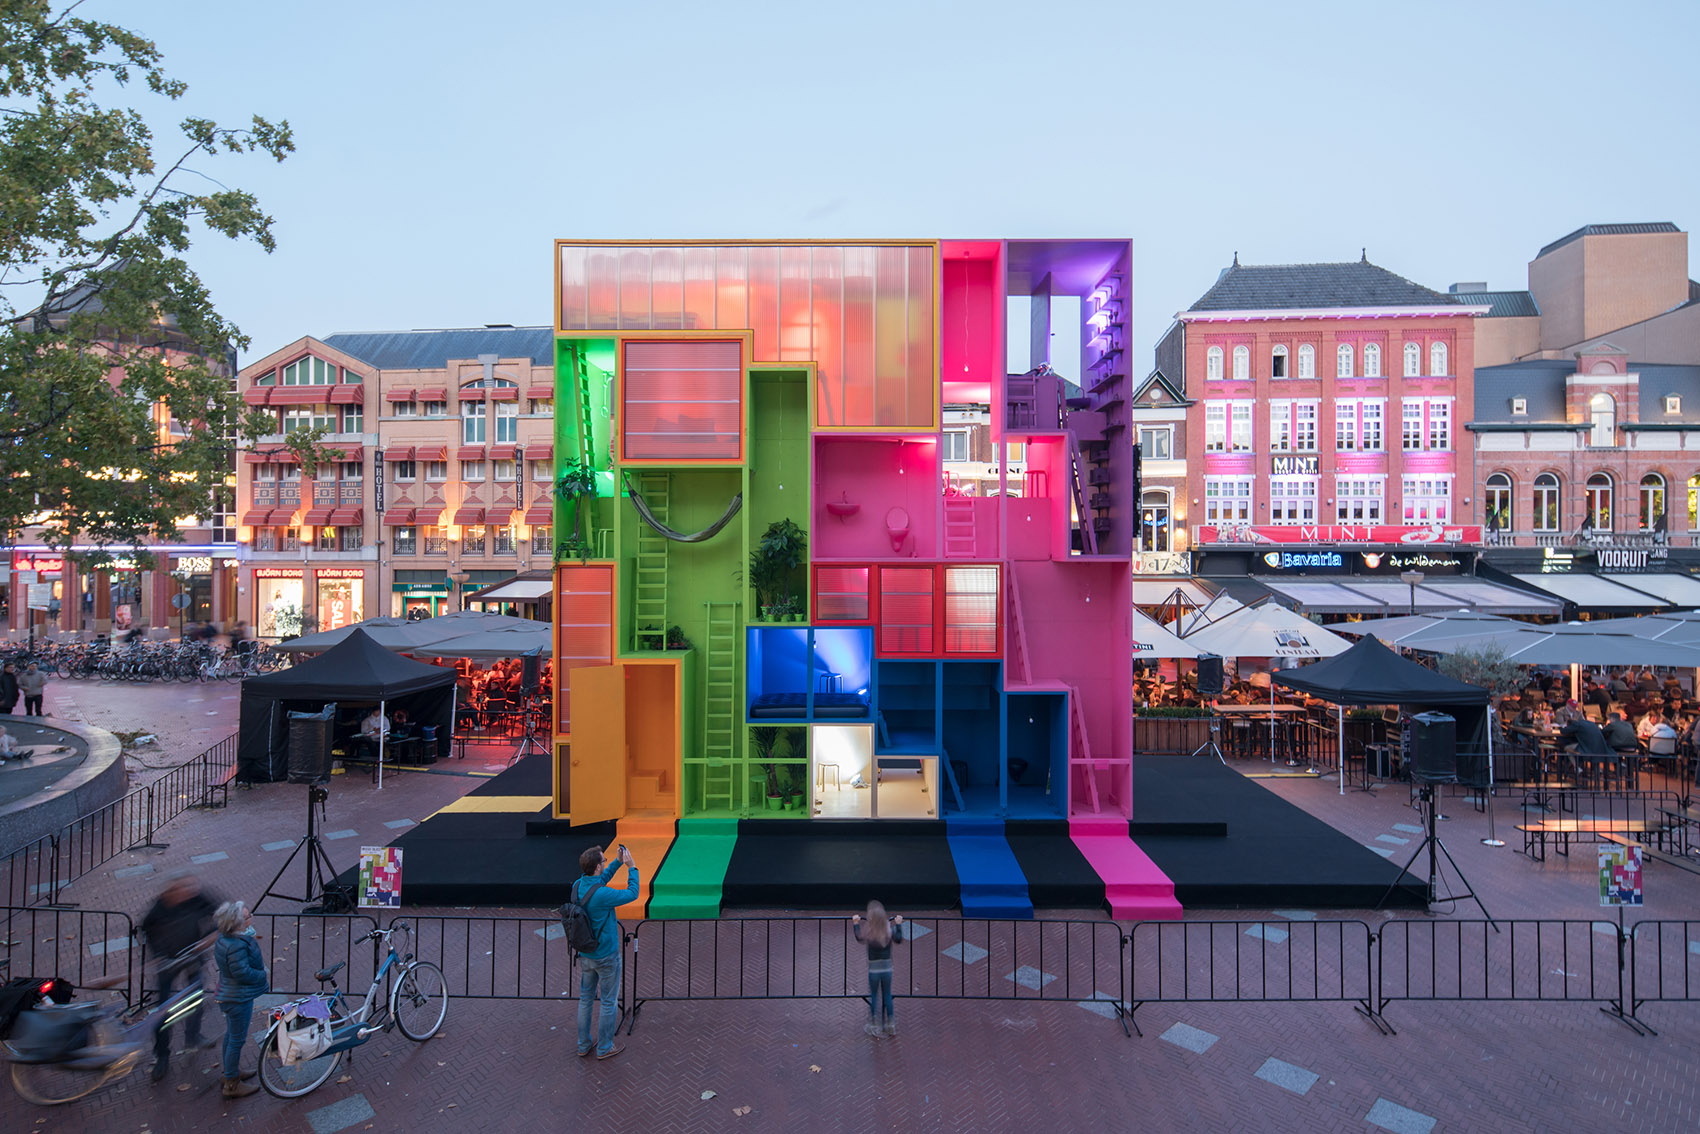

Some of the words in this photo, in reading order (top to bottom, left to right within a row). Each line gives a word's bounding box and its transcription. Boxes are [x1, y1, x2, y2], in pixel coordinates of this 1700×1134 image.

[1274, 457, 1318, 471] MINT
[1301, 526, 1376, 539] MINT
[178, 557, 212, 569] BOSS
[1283, 552, 1342, 567] Bavaria
[1389, 555, 1402, 567] de
[1597, 550, 1648, 567] VOORUIT
[257, 568, 281, 577] BJÖRN
[282, 569, 304, 577] BORG
[317, 568, 341, 577] BJÖRN
[342, 569, 364, 577] BORG
[331, 600, 344, 630] SAL
